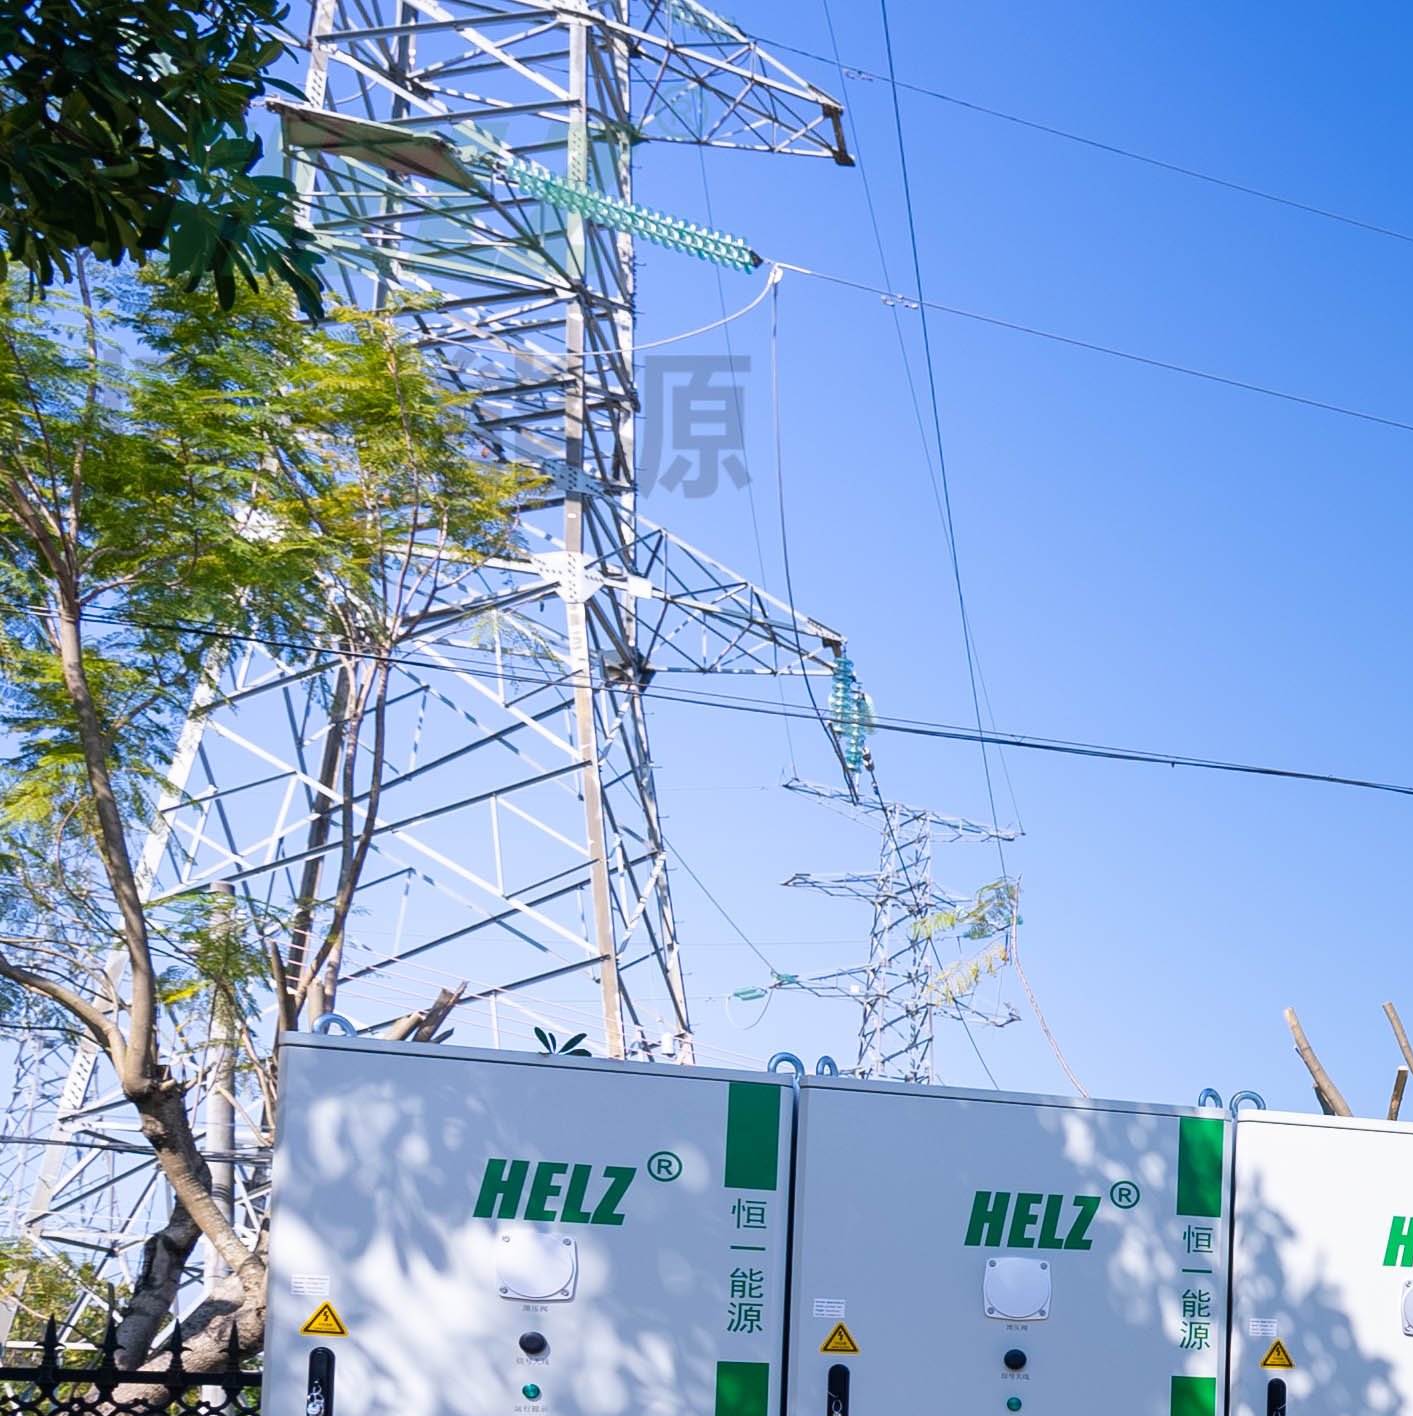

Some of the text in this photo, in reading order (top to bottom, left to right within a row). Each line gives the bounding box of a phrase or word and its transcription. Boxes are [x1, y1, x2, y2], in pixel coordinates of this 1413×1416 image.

[473, 1158, 636, 1225] HELZ
[964, 1190, 1101, 1250] HELZ
[727, 1197, 768, 1335] 恒一能源
[1178, 1224, 1214, 1352] 恒一能源
